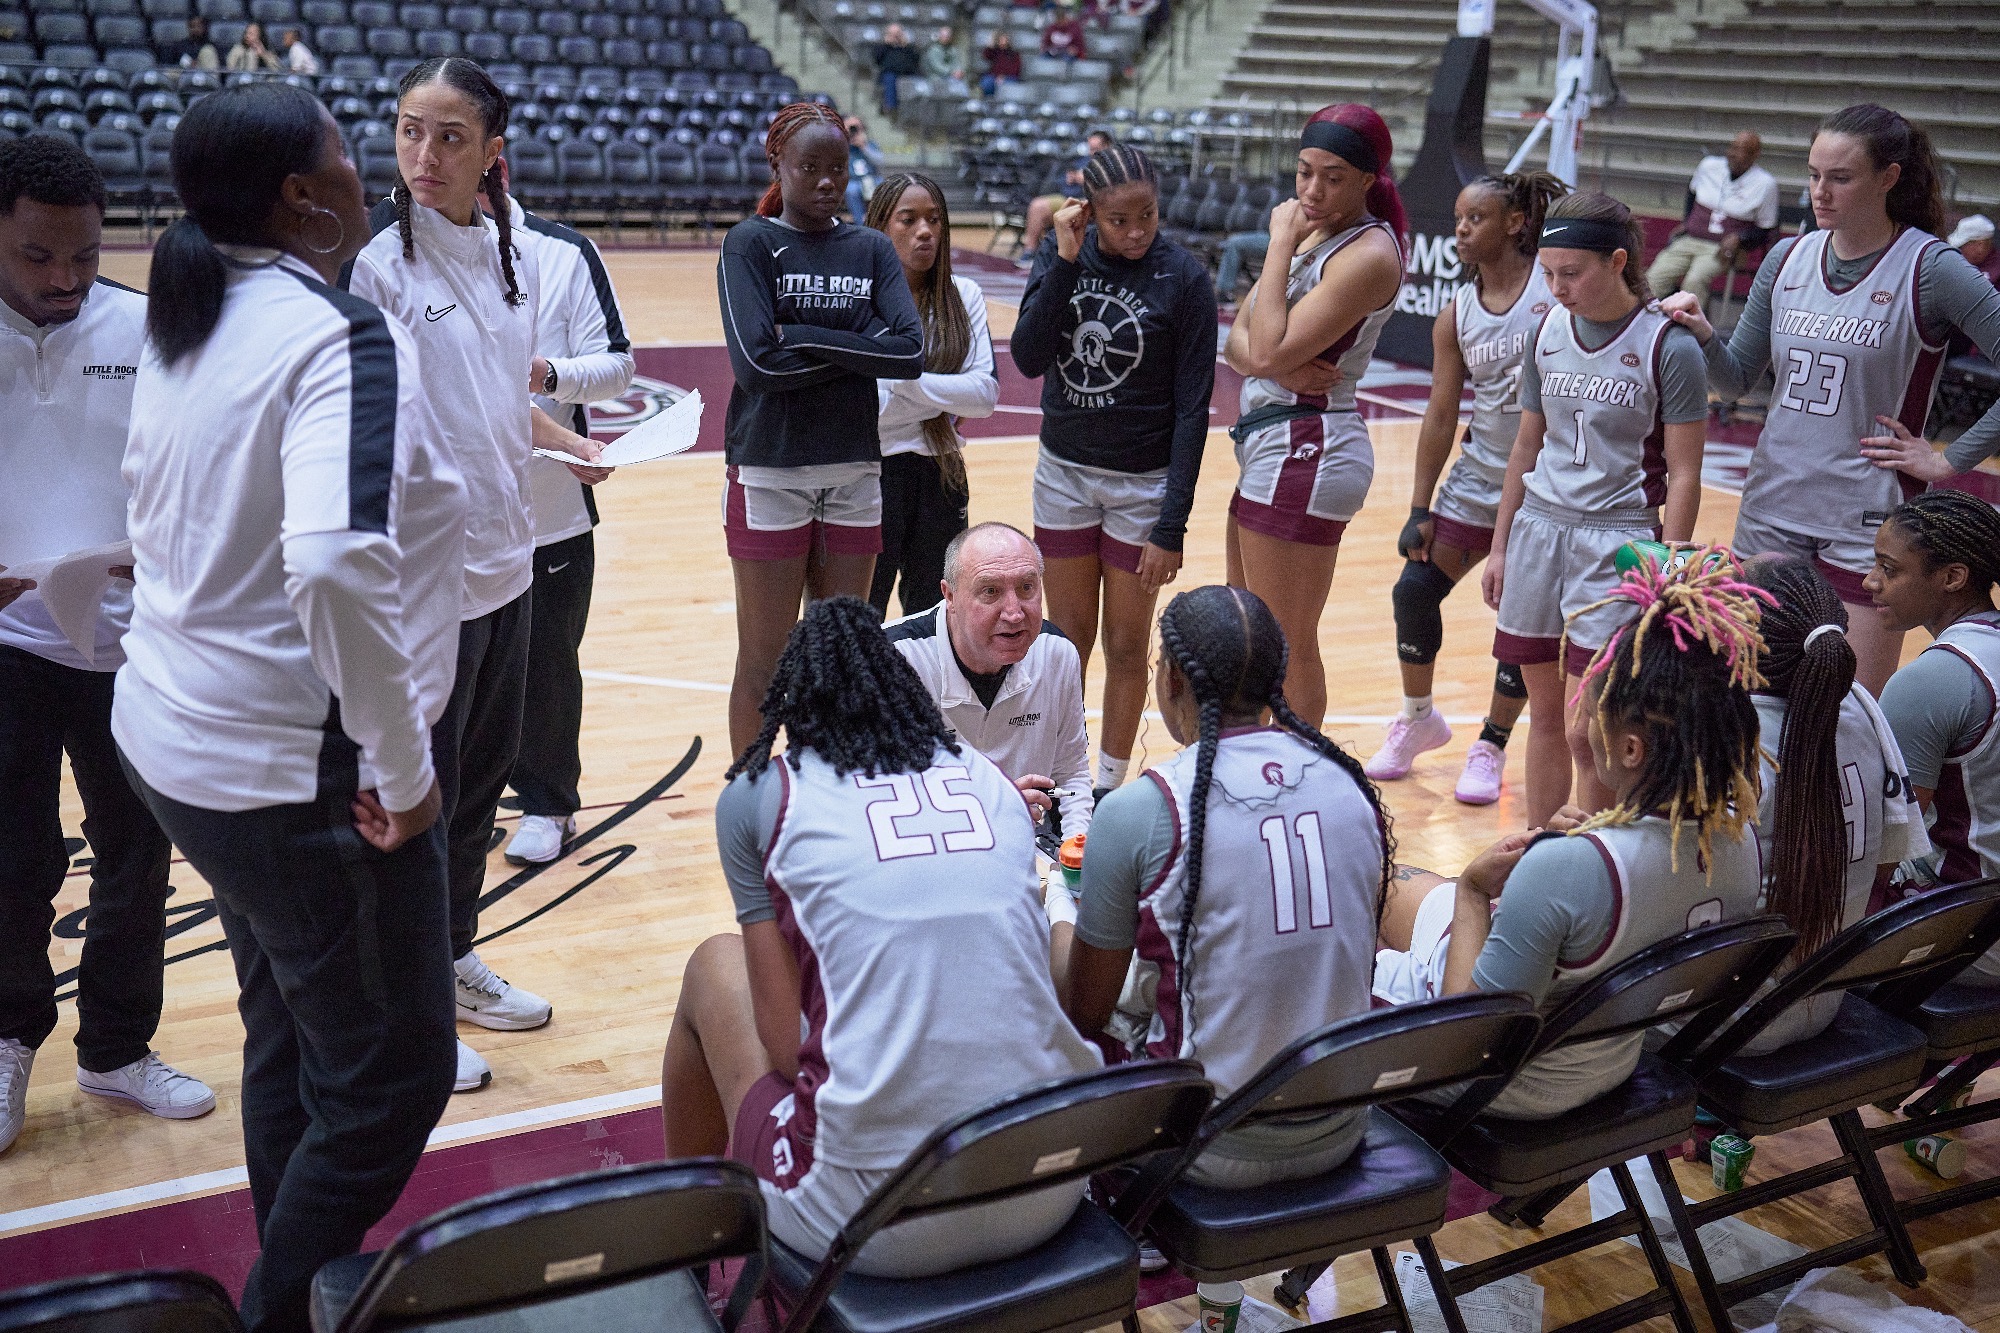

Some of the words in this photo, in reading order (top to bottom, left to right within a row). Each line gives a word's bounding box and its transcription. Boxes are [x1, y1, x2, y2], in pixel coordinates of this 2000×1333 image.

[795, 296, 854, 310] TROJANS
[829, 275, 873, 297] ROCK
[1073, 278, 1114, 294] ITTLE
[1116, 286, 1150, 318] ROCK
[1823, 315, 1891, 349] ROCK
[83, 365, 113, 374] LITTLE
[114, 365, 138, 375] ROCK
[1780, 347, 1849, 418] 23
[1062, 384, 1116, 409] TROJANS
[1582, 374, 1643, 409] ROCK
[1573, 409, 1588, 467] 1
[853, 765, 996, 863] 25
[1259, 810, 1333, 935] 11
